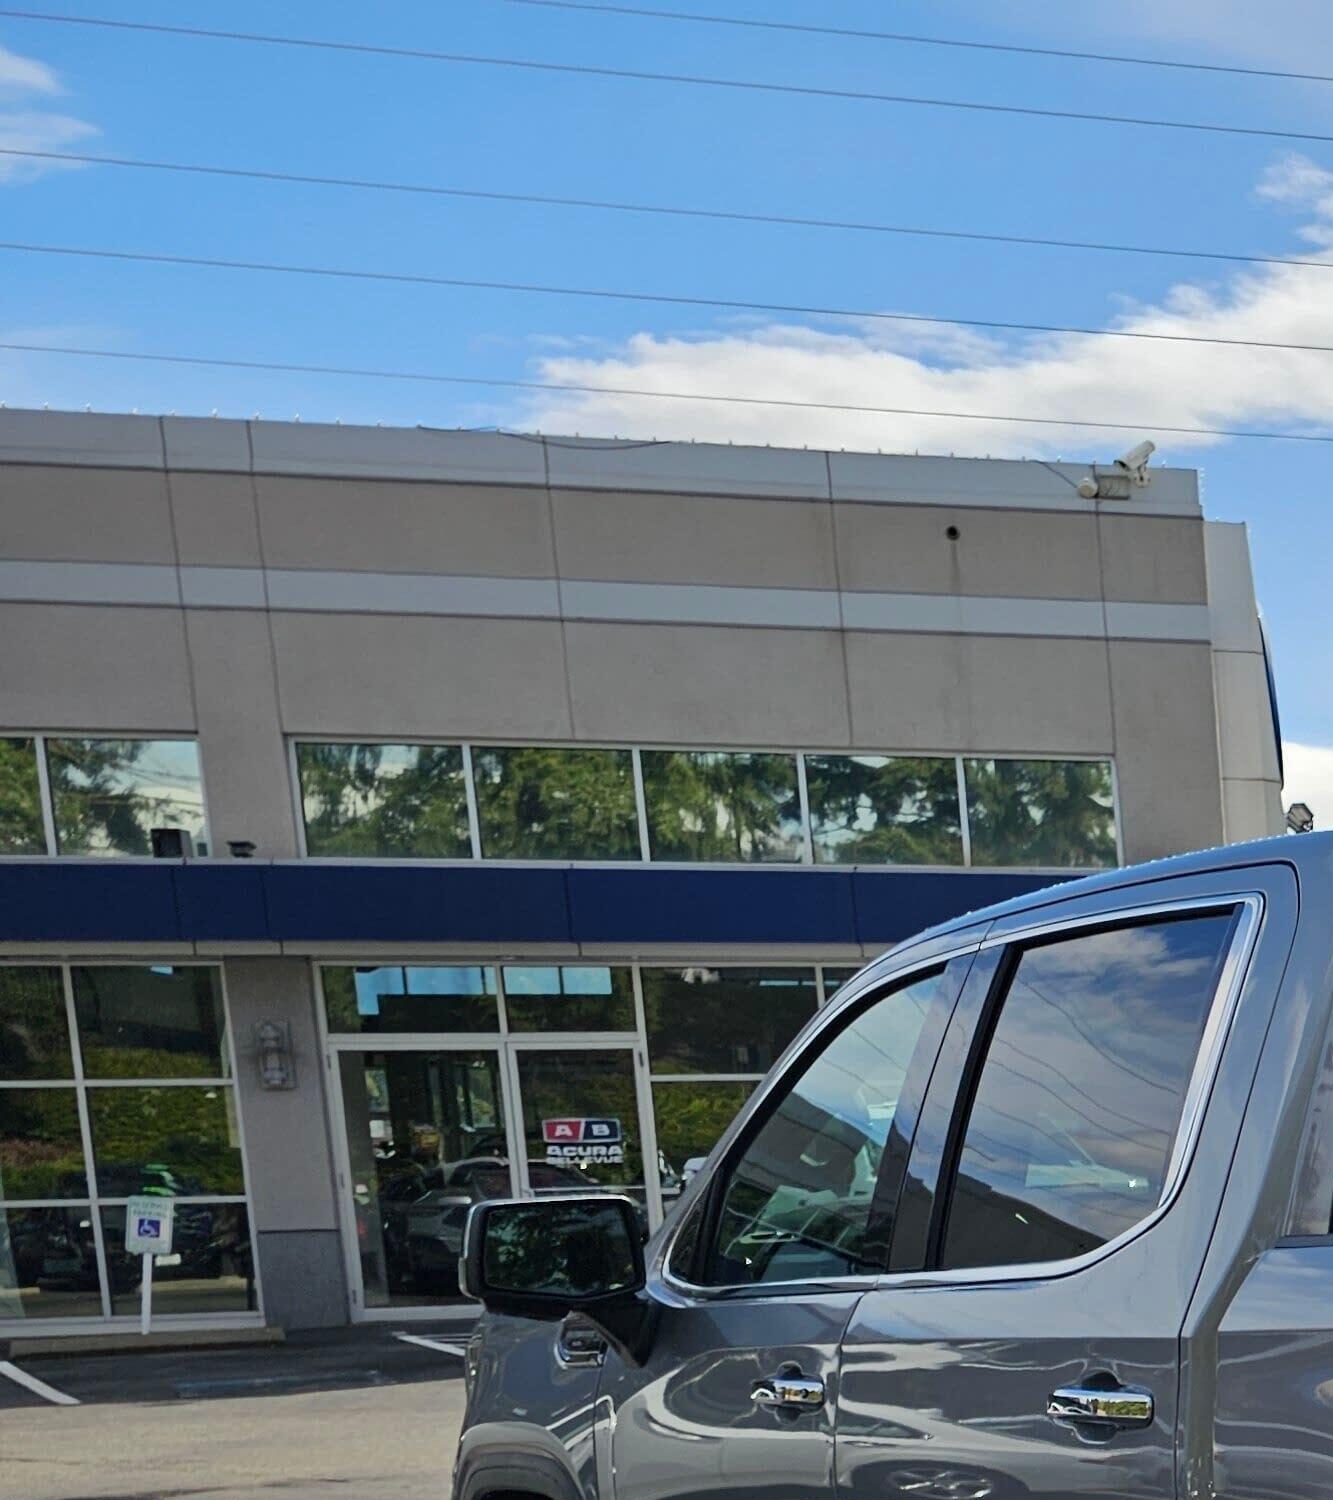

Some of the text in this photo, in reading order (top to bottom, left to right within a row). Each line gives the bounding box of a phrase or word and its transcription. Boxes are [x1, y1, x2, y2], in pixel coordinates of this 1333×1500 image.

[554, 1124, 610, 1136] A B
[546, 1145, 623, 1157] ACURA
